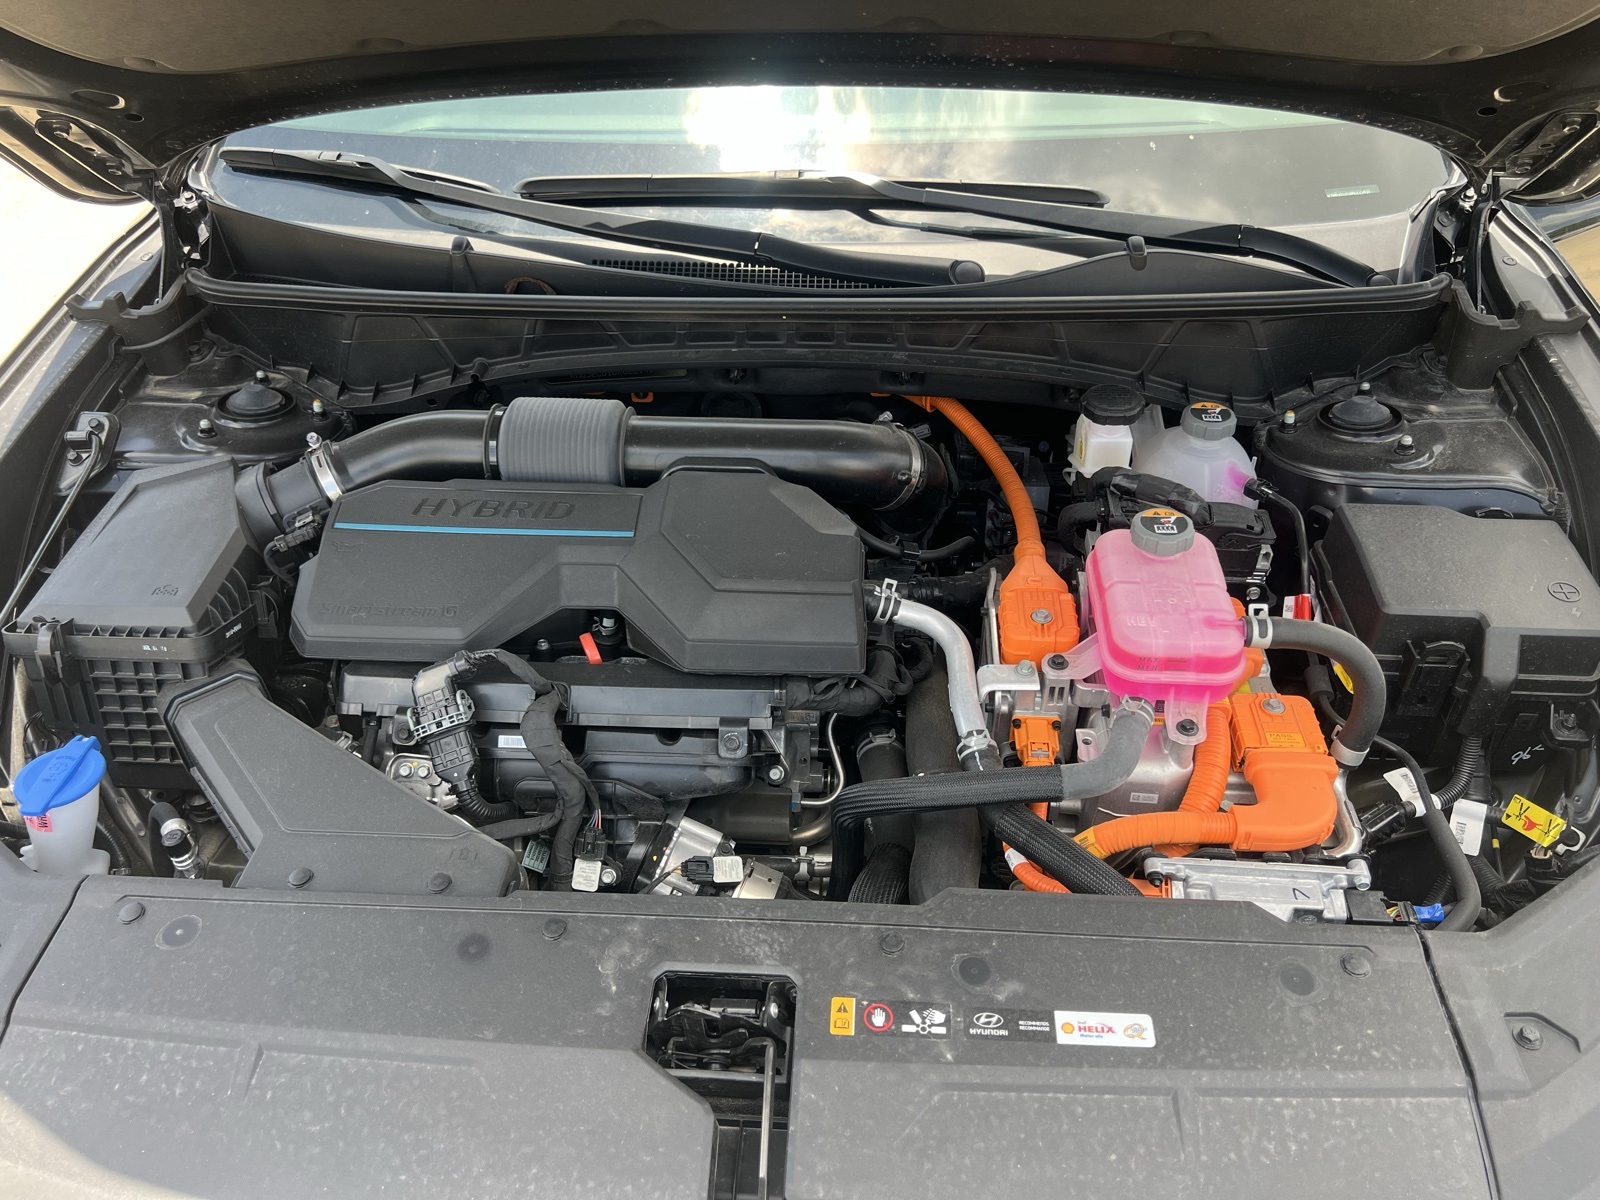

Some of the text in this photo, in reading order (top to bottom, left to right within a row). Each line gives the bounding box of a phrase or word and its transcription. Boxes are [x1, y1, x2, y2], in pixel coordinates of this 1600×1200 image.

[411, 498, 575, 520] HYBRID
[969, 1028, 1009, 1036] HYUNDAI
[1077, 1025, 1116, 1034] HELIX
